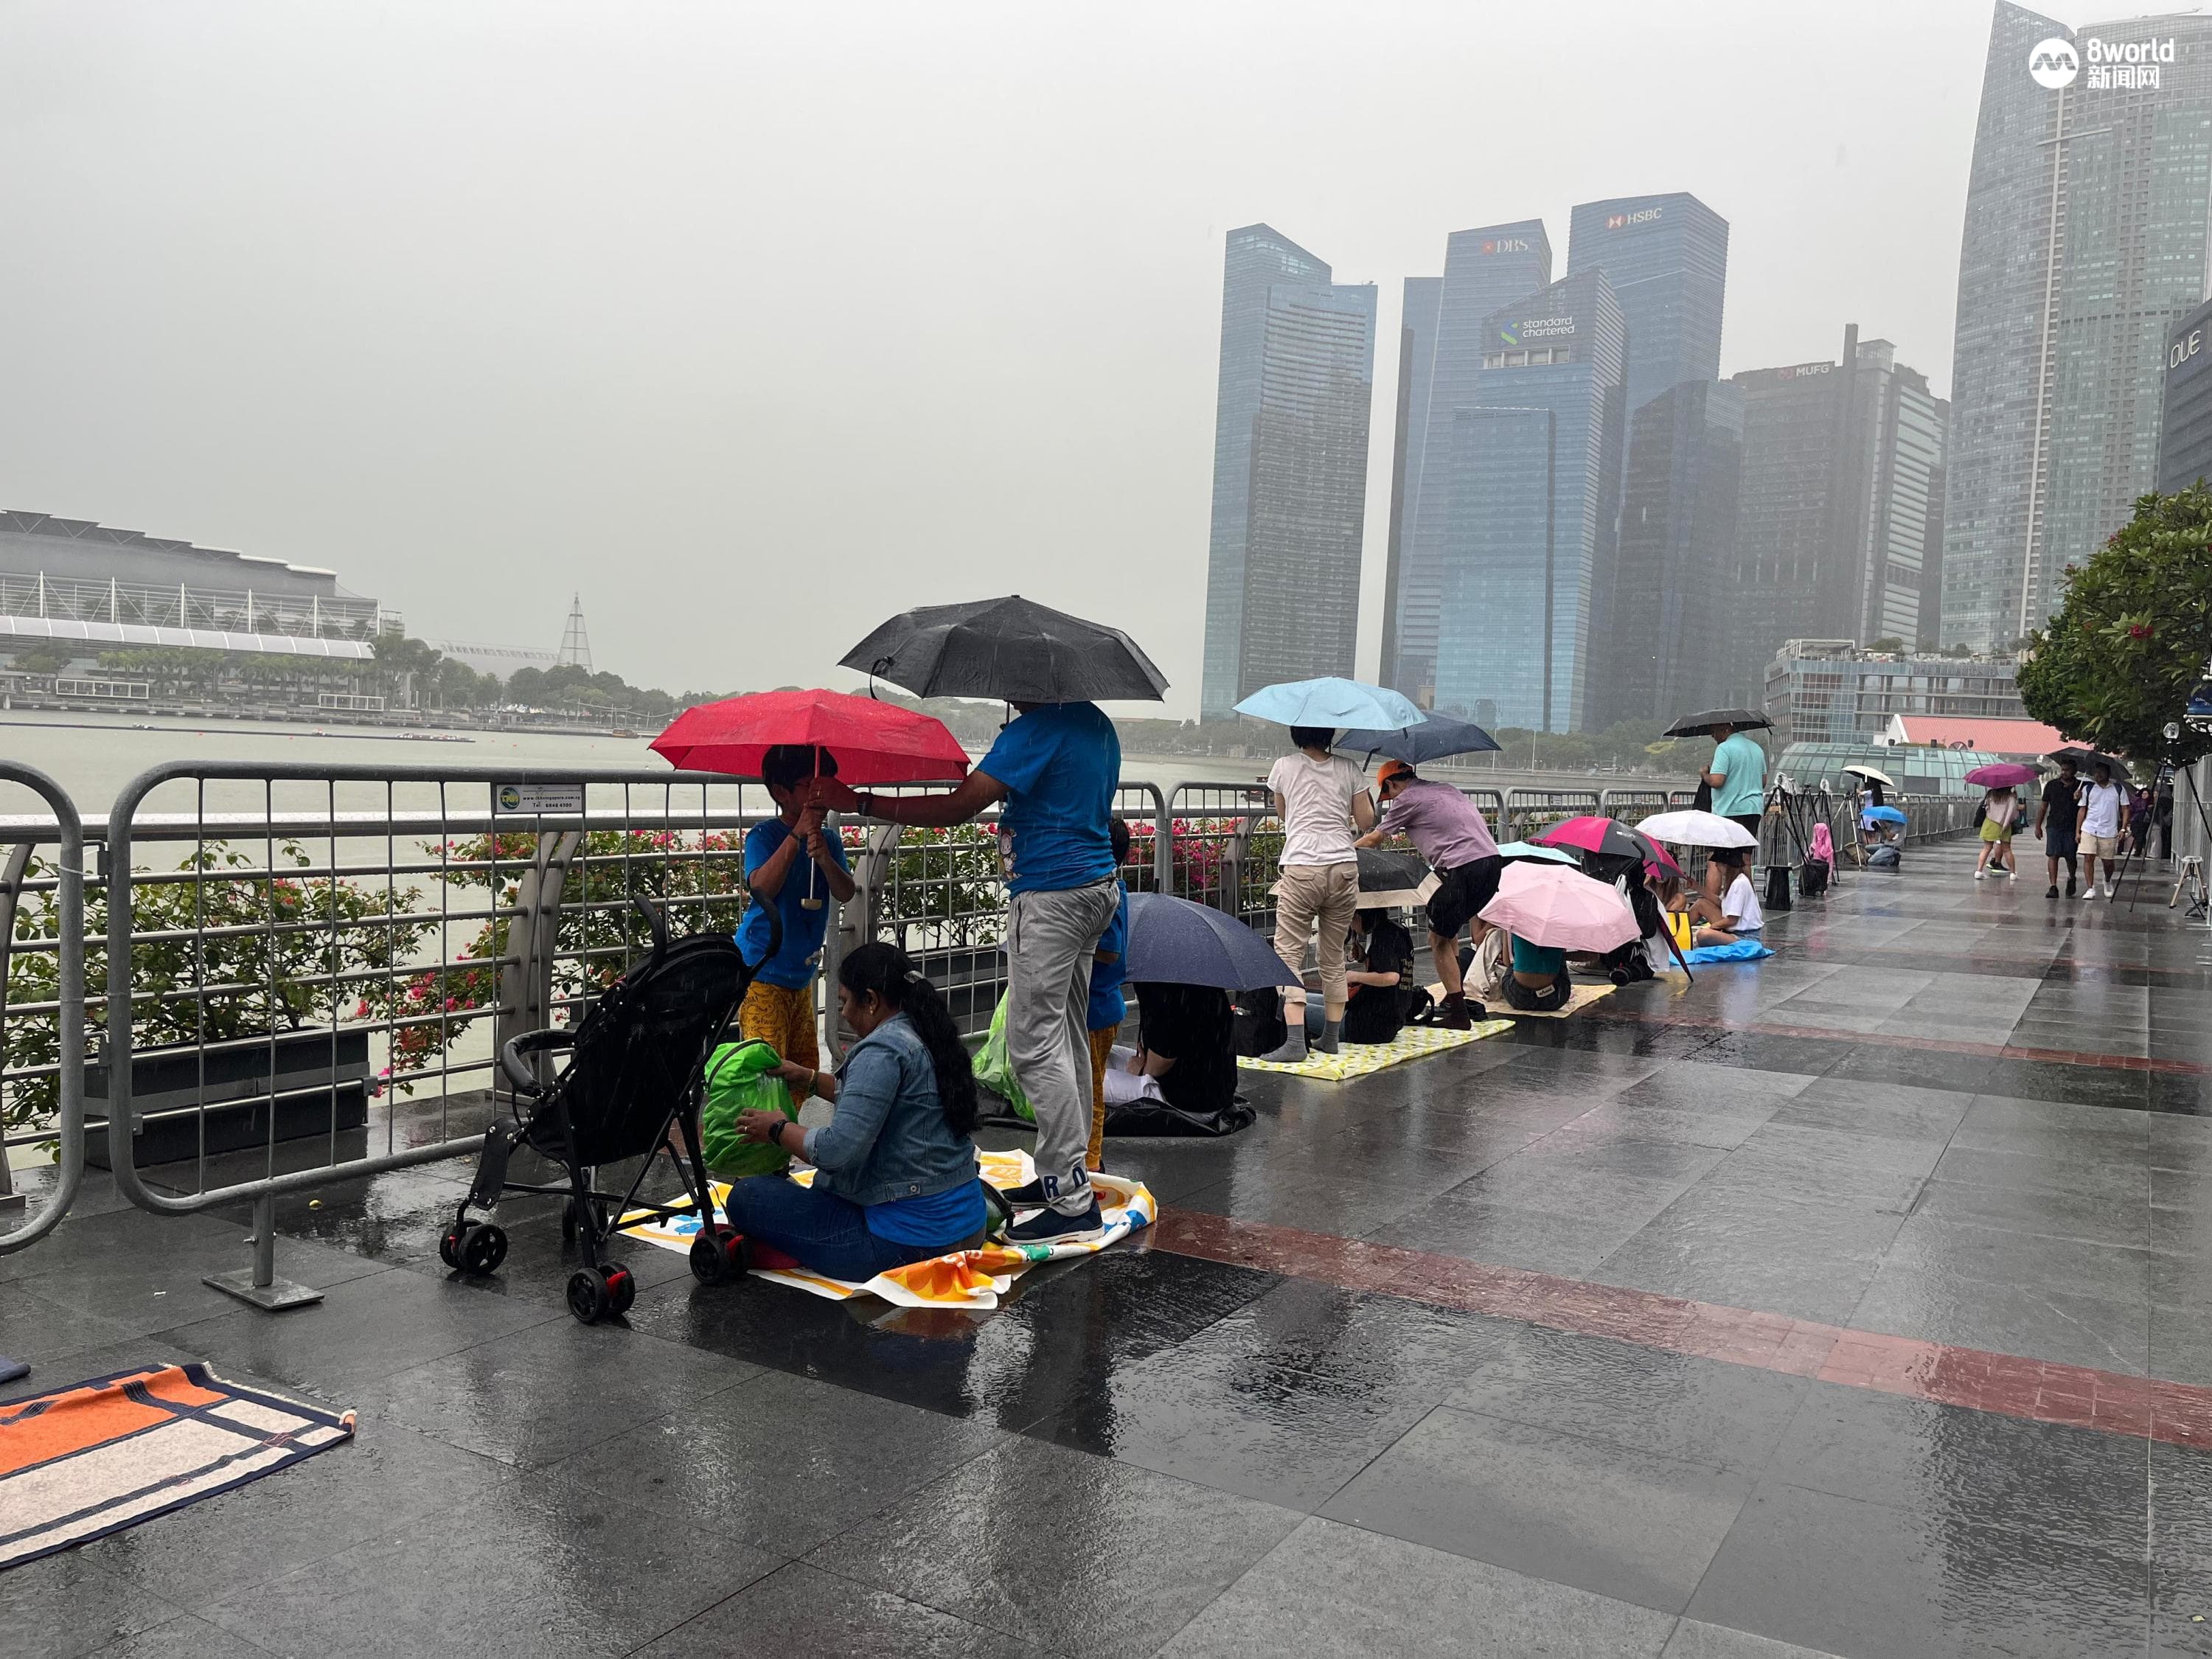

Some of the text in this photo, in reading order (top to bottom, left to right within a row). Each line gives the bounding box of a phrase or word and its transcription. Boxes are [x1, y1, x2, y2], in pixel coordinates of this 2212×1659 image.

[1627, 208, 1663, 225] HSBC
[1497, 239, 1528, 253] DBS
[1523, 316, 1573, 329] standard
[1523, 324, 1575, 338] chartered
[2170, 330, 2201, 369] OUE
[1795, 364, 1829, 378] MUFG
